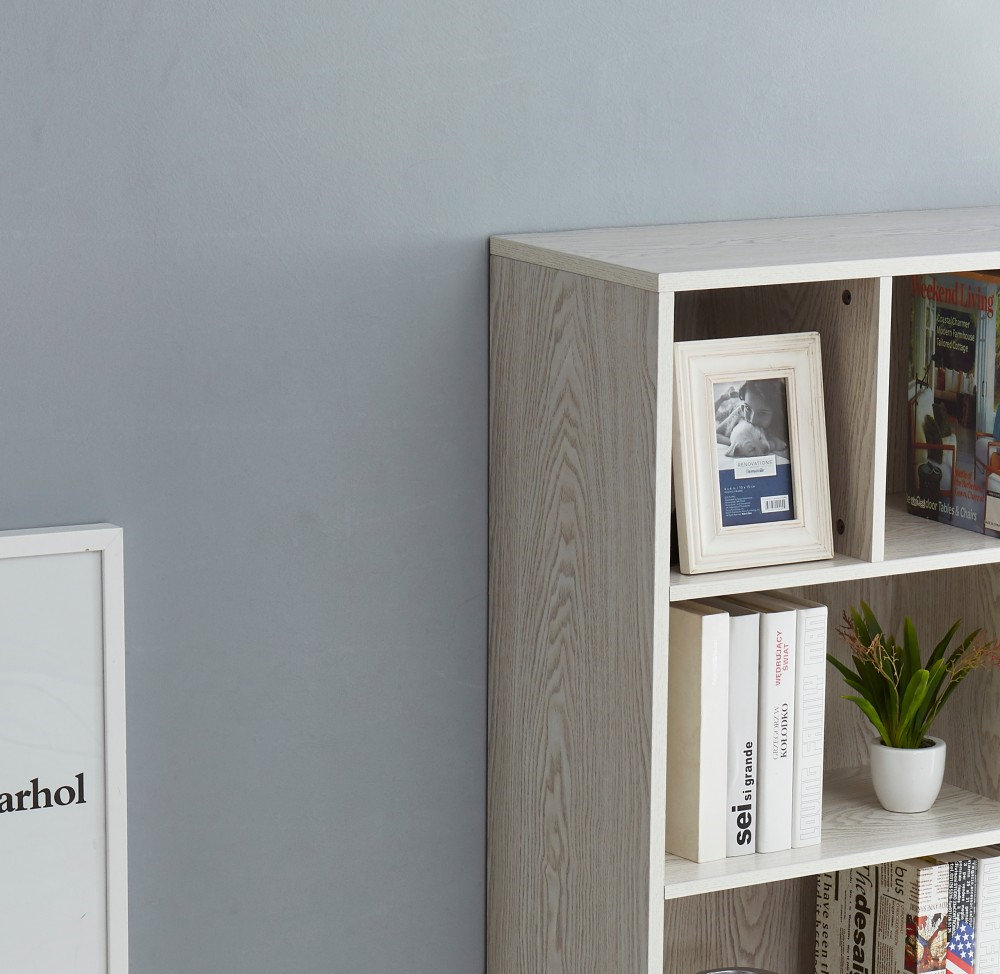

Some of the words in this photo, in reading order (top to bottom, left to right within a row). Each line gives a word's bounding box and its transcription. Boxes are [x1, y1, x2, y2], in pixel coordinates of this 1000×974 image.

[960, 282, 994, 318] Living
[938, 502, 955, 516] Tables
[960, 507, 977, 521] Chairs
[743, 741, 755, 786] grande
[743, 790, 752, 801] si
[731, 803, 752, 846] sei
[895, 866, 908, 895] bus
[822, 882, 832, 919] have
[821, 922, 829, 958] seen
